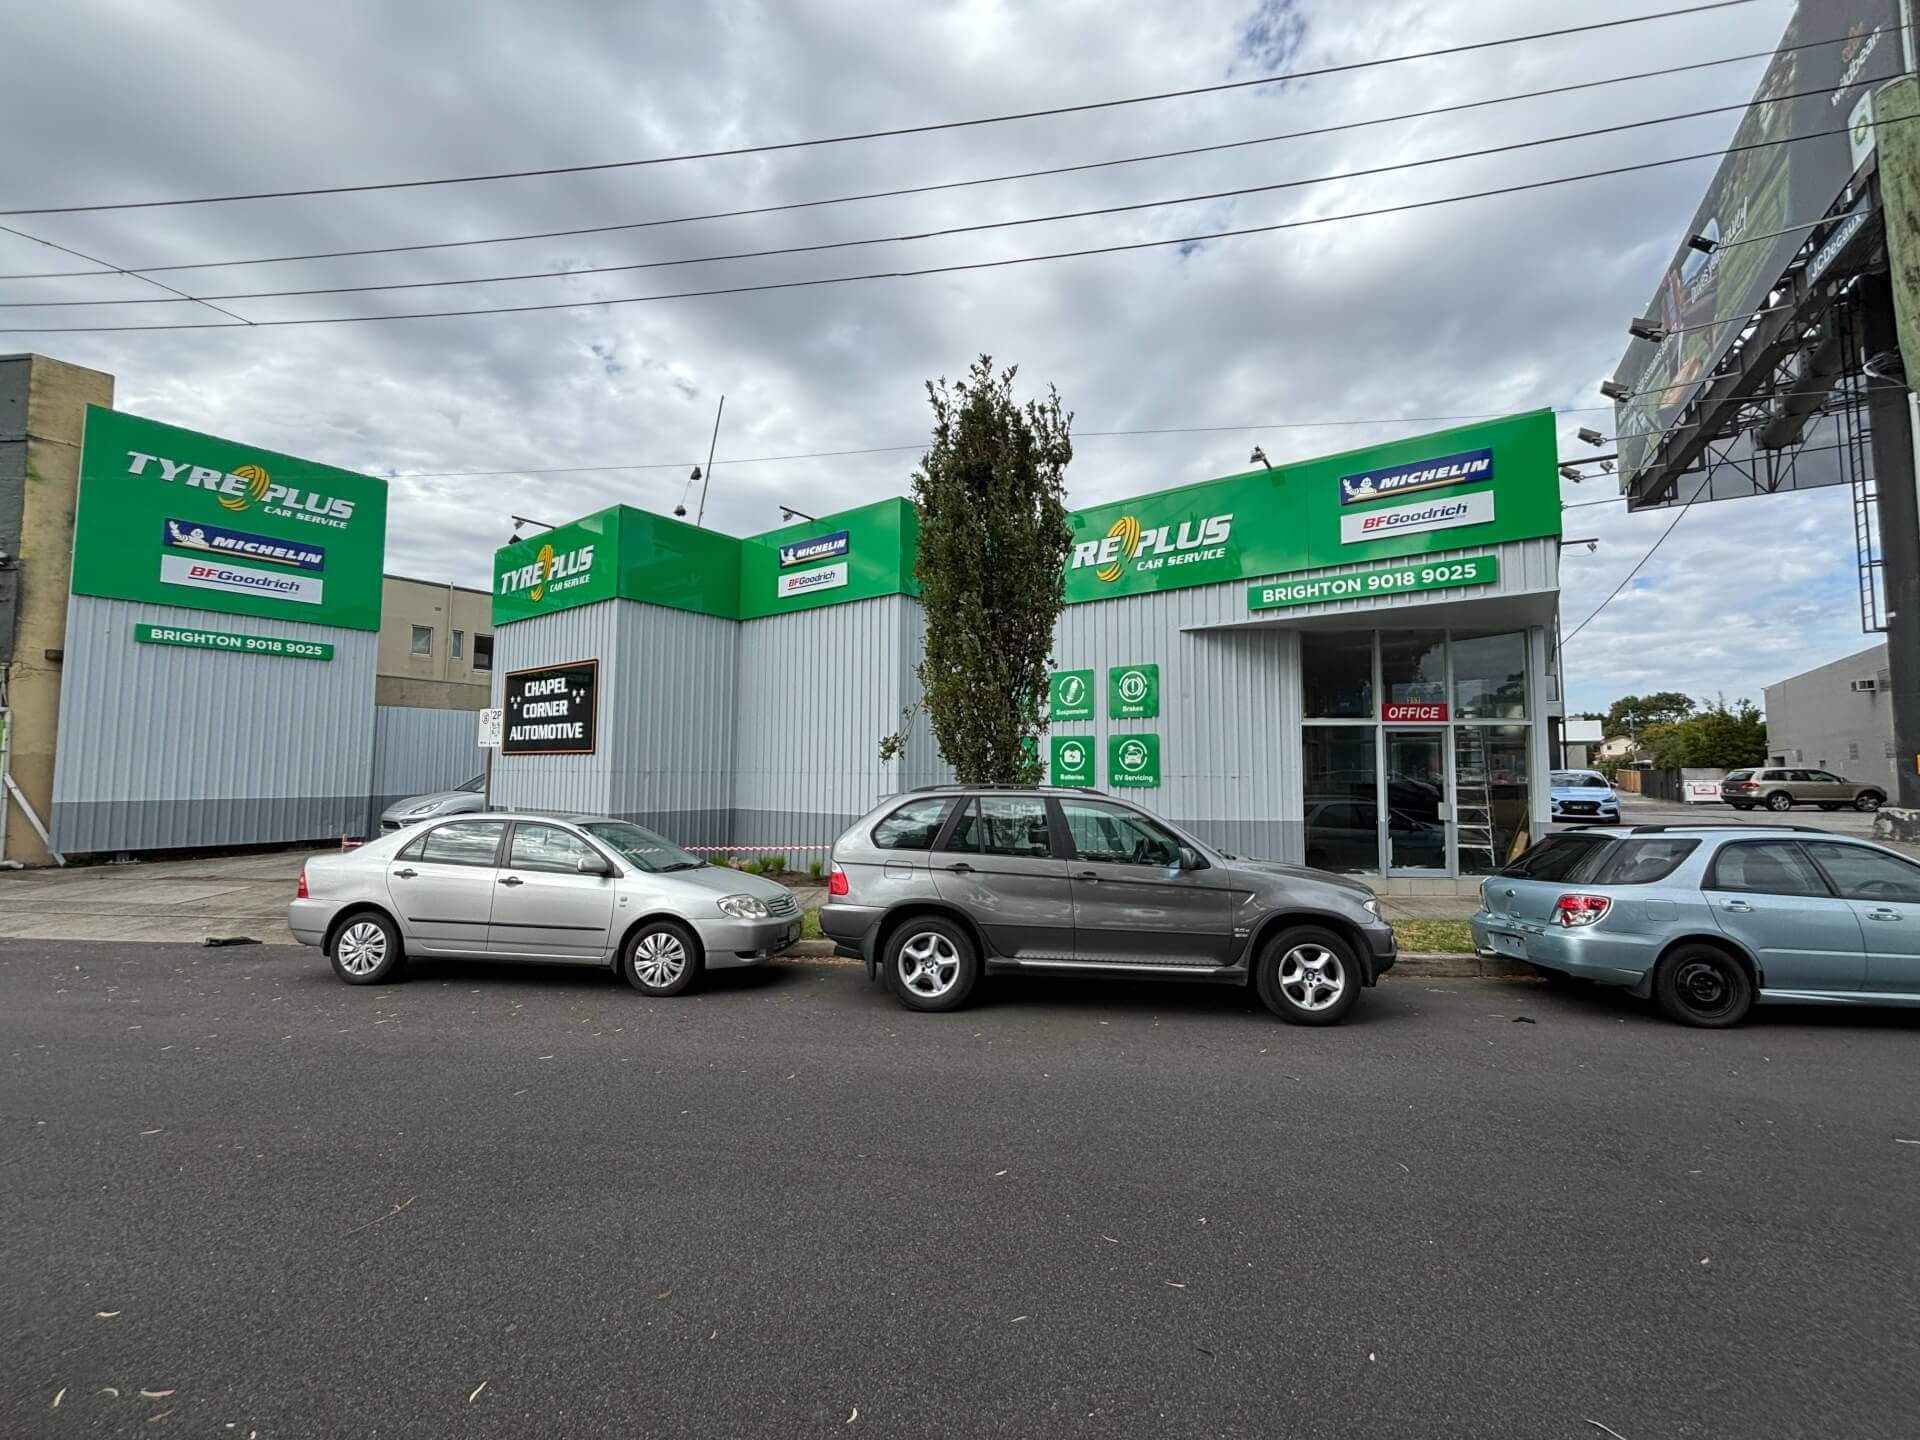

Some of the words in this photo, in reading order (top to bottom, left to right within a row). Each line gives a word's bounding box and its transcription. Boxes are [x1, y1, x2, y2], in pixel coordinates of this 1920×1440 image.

[1811, 214, 1863, 278] JCDecaux
[1379, 458, 1490, 490] MICHELIN
[263, 505, 292, 518] CAR
[295, 512, 348, 529] SERVICE
[1362, 503, 1468, 530] BFGoodrich
[211, 536, 323, 564] MICHELIN
[796, 538, 847, 558] MICHELIN
[1071, 535, 1122, 570] RE
[1136, 557, 1163, 571] CAR
[1167, 547, 1226, 567] SERVICE
[189, 565, 301, 592] BFGoodrich
[549, 582, 564, 593] CAR
[563, 573, 591, 589] SERVICE
[788, 570, 836, 588] BFGoodrich
[1262, 579, 1362, 604] BRIGHTON
[1367, 571, 1416, 591] 9018
[1421, 563, 1477, 584] 9025
[150, 628, 242, 648] BRIGHTON
[246, 639, 282, 652] 9018
[286, 643, 323, 656] 9025
[524, 677, 569, 697] CHAPEL
[522, 699, 569, 719] CORNER
[1055, 708, 1089, 716] Suspension
[1388, 706, 1440, 719] OFFICE
[509, 722, 584, 741] AUTOMOTIVE
[1124, 774, 1153, 783] Servicing
